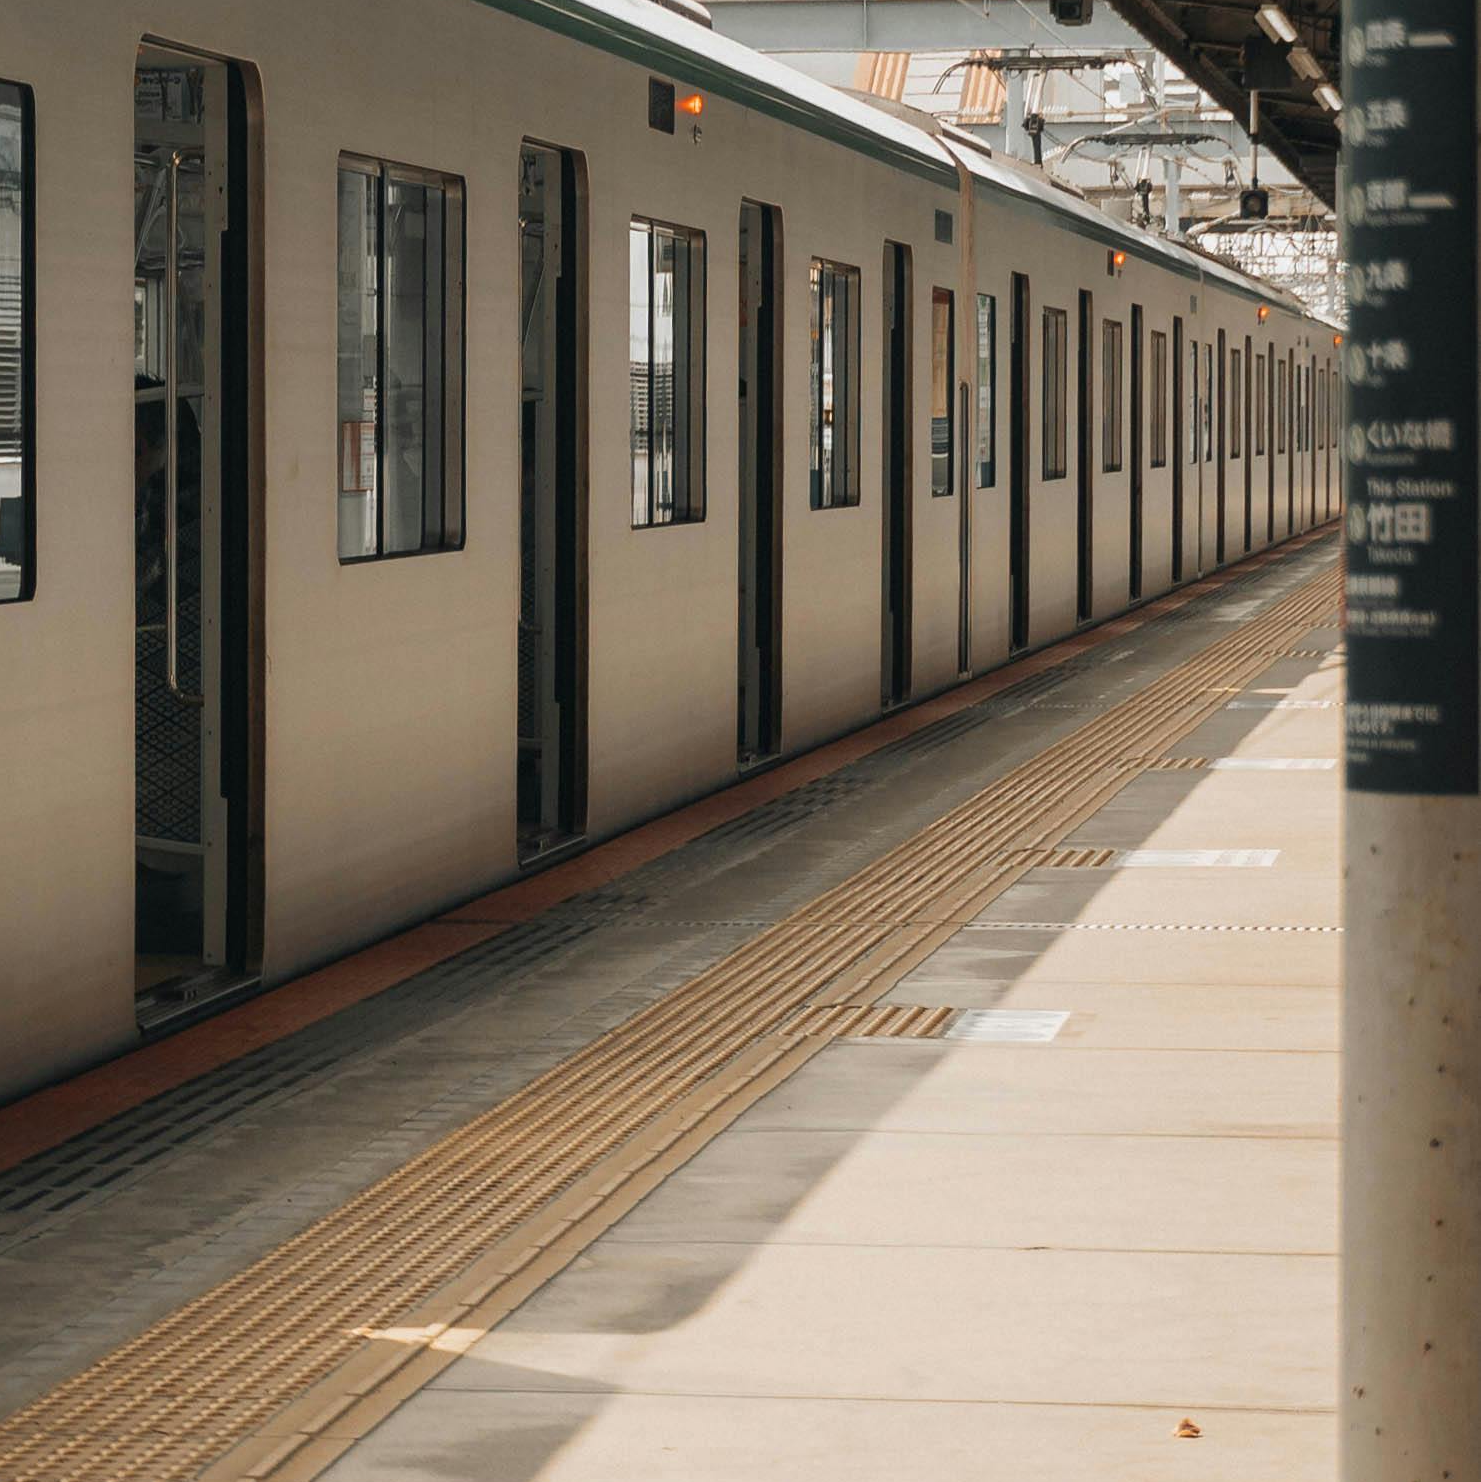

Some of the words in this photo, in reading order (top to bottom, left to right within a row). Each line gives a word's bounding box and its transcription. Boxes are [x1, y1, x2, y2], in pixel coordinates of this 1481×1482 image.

[1367, 479, 1394, 497] This
[1396, 479, 1453, 498] Station
[1367, 503, 1432, 543] 竹田
[1367, 547, 1415, 564] Takeda
